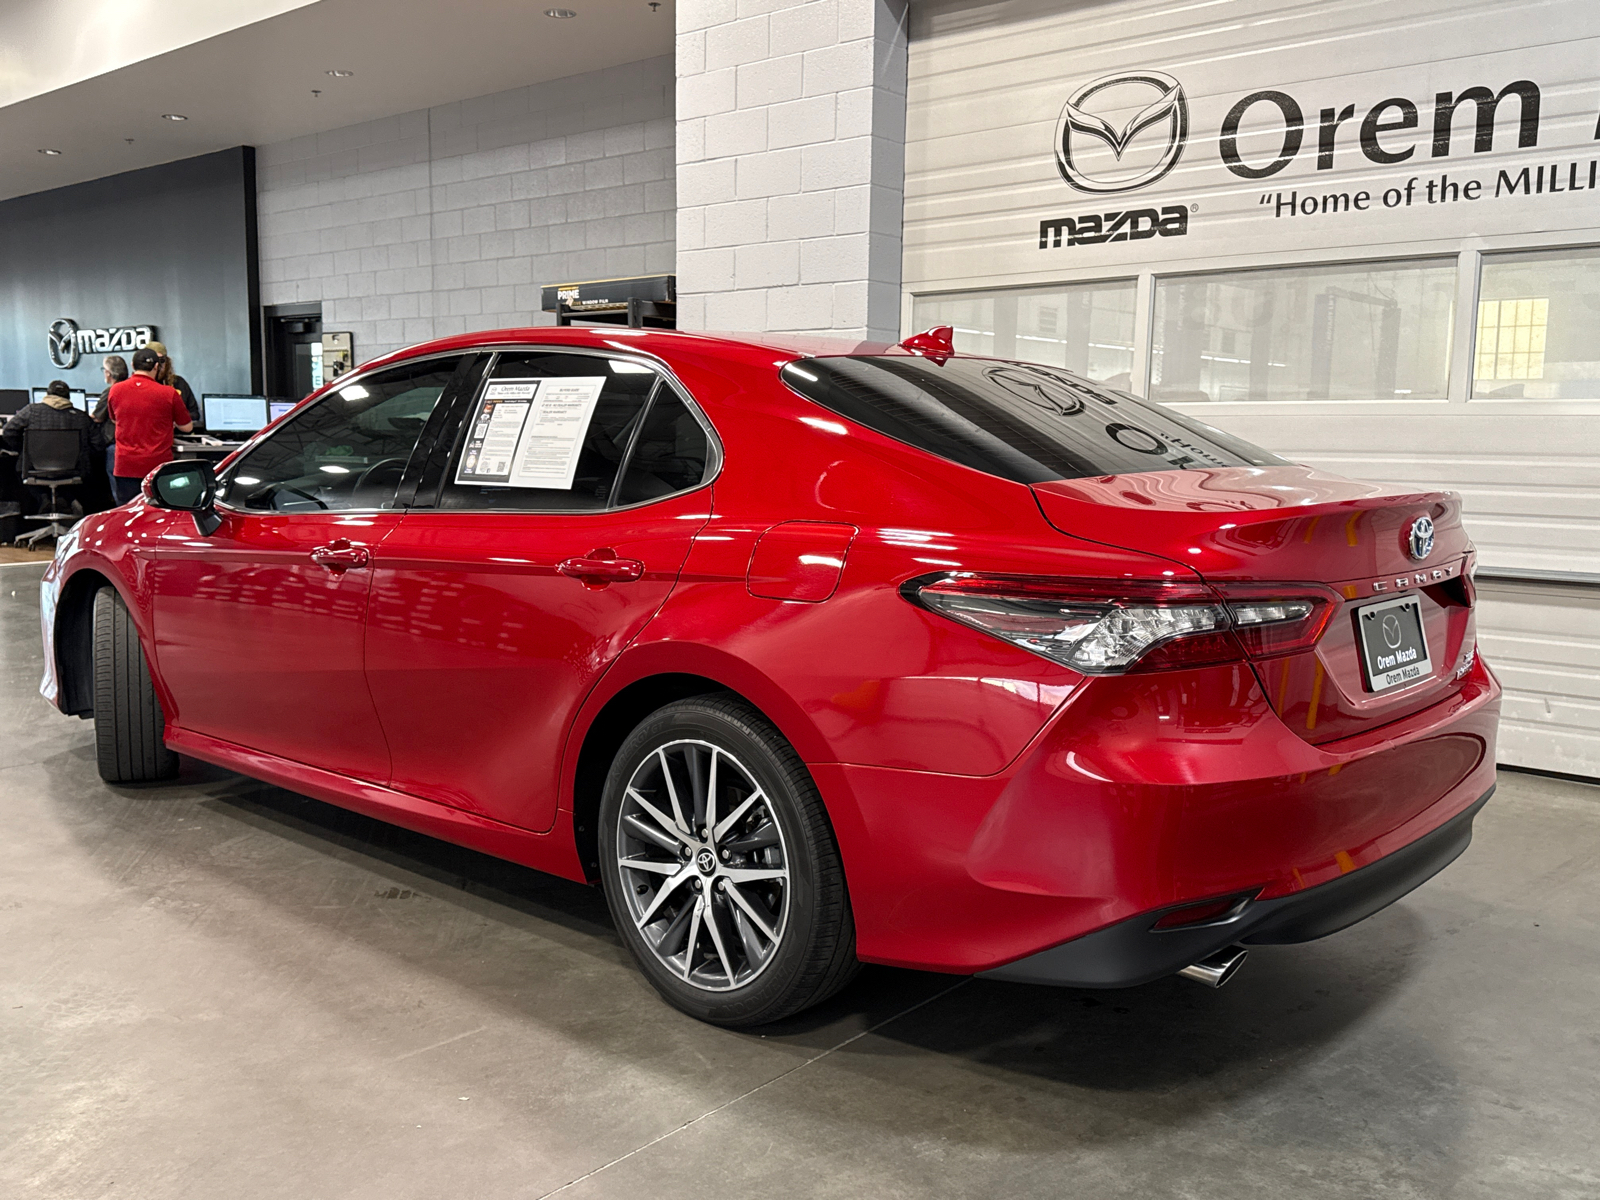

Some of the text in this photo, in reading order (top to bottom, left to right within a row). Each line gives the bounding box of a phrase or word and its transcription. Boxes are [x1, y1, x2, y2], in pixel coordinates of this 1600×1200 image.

[1219, 79, 1541, 179] Orem
[1382, 177, 1419, 208] of
[1426, 174, 1482, 204] the
[557, 289, 580, 300] PRIME
[1373, 567, 1454, 591] CAMRY
[1377, 647, 1417, 669] Orem Mazda
[1386, 666, 1420, 684] Orem Mazda
